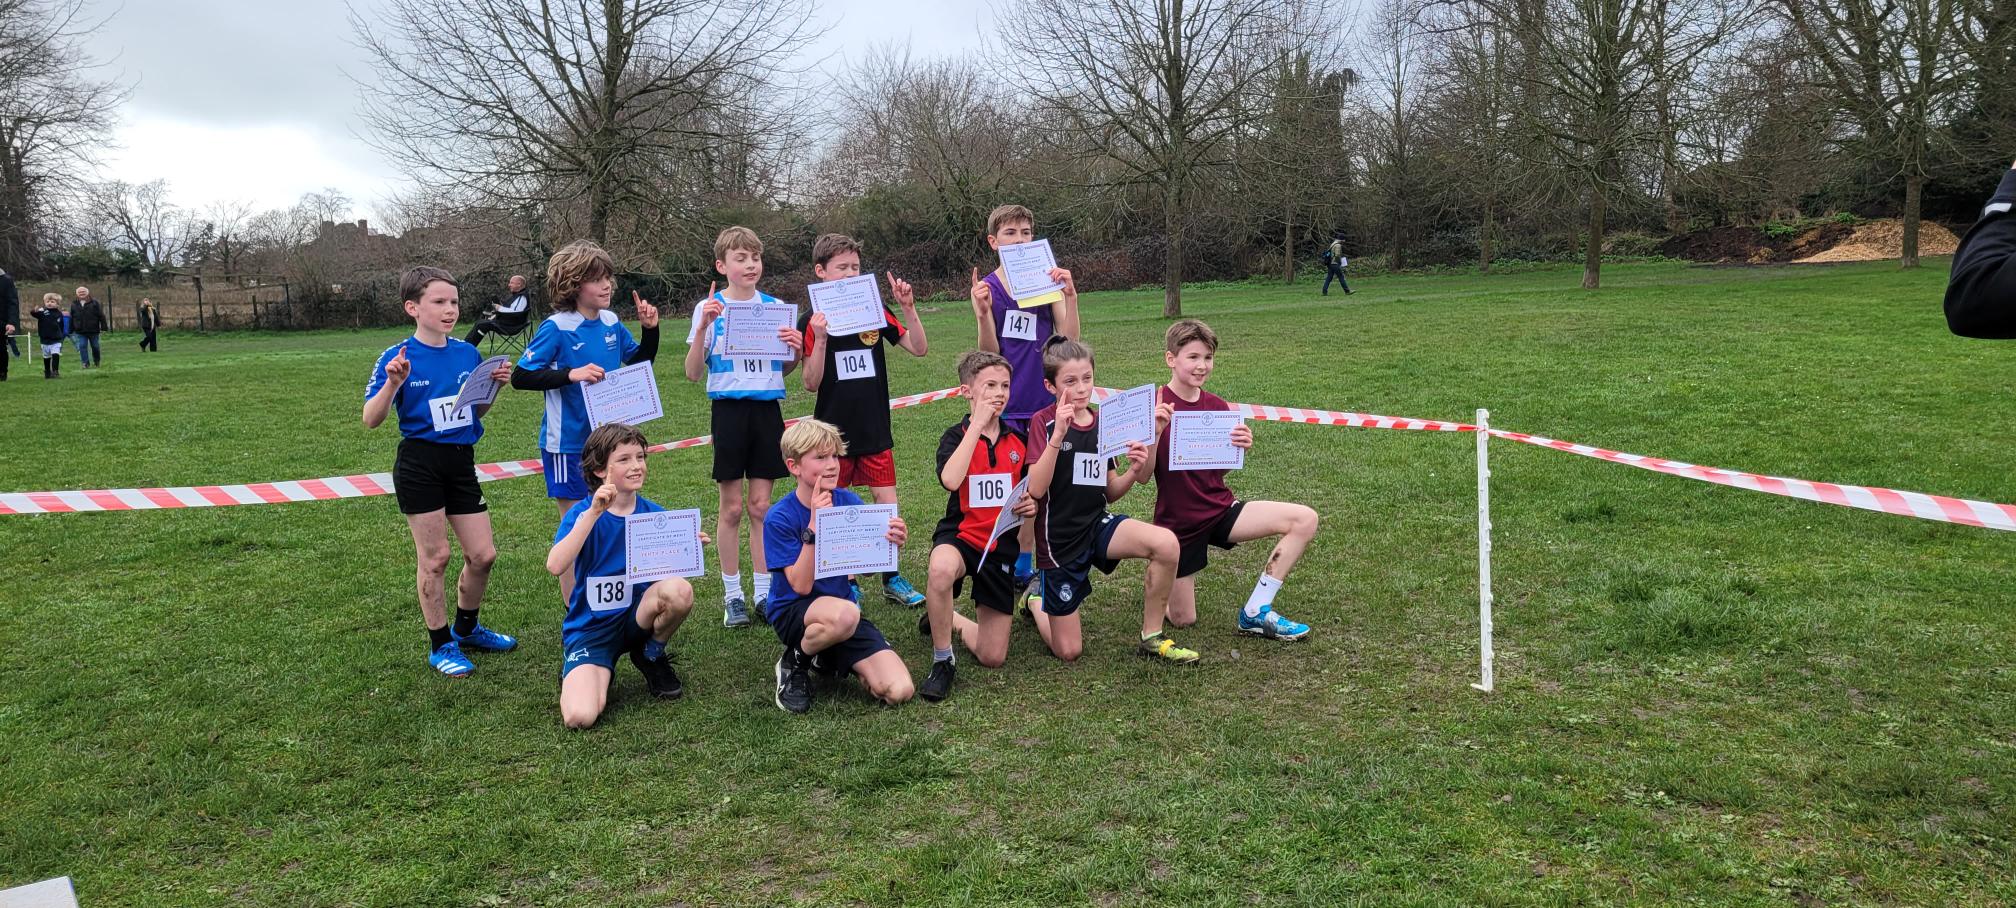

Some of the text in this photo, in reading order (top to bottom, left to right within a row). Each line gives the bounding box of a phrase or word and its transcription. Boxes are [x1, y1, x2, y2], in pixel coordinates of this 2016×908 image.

[1009, 315, 1030, 333] 147
[743, 359, 763, 373] 181
[843, 354, 867, 374] 104
[410, 379, 430, 388] mitre
[1082, 458, 1100, 479] 113
[978, 480, 1004, 501] 106
[595, 581, 625, 603] 138
